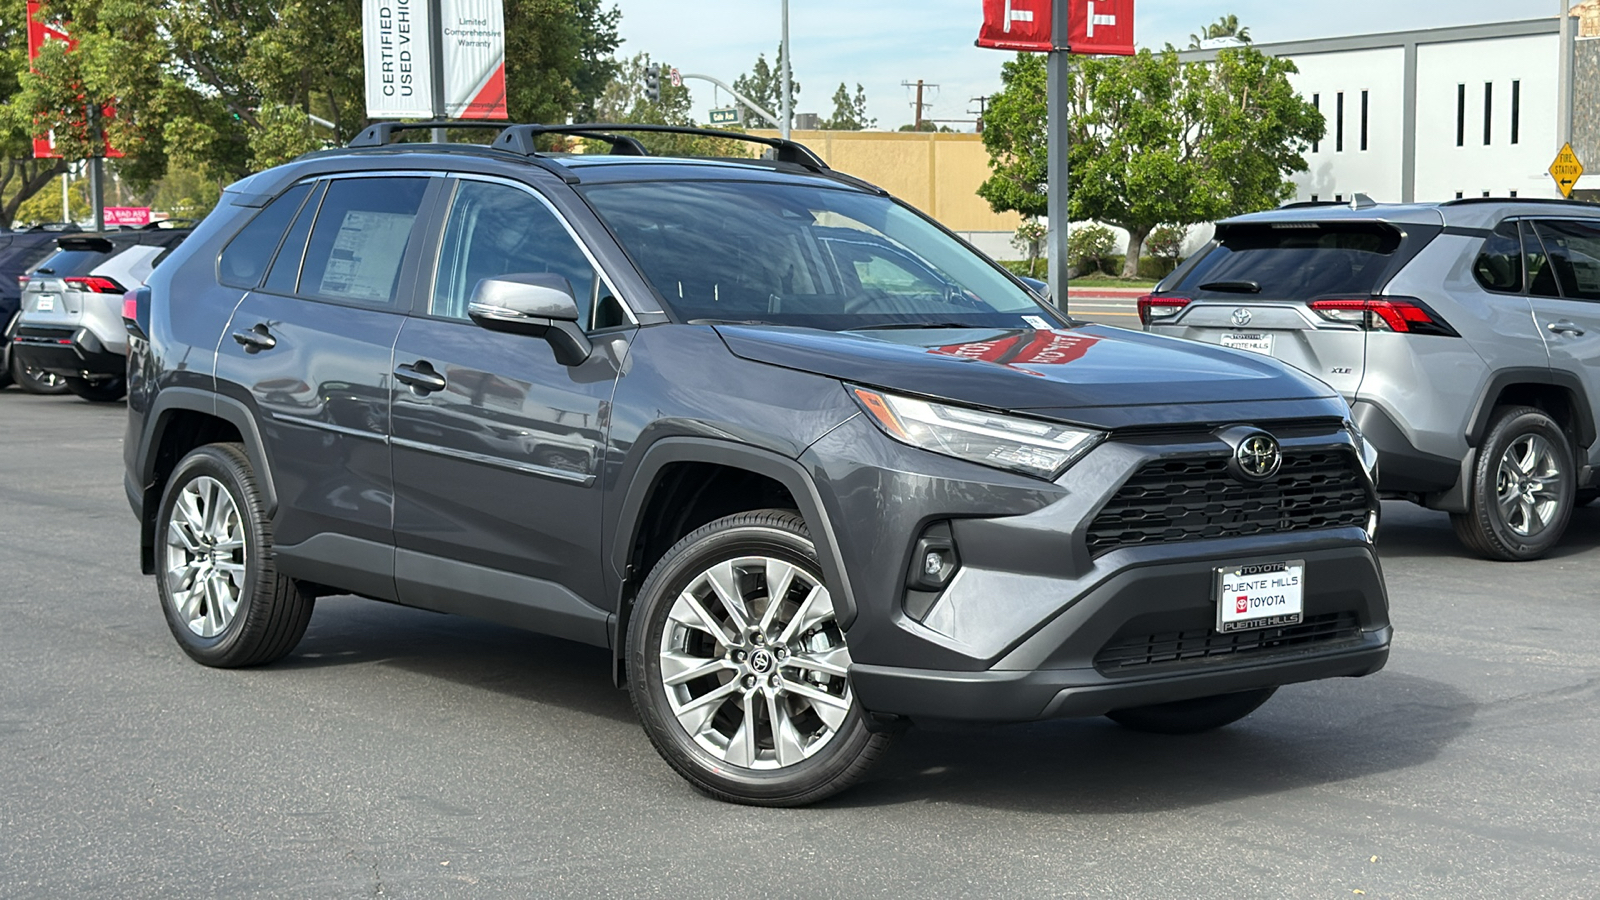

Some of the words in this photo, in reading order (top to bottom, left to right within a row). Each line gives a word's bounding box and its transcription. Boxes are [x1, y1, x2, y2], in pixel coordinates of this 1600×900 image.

[459, 18, 487, 26] Limited
[444, 28, 501, 37] Comprehensive
[458, 40, 491, 49] Warranty
[380, 7, 395, 96] CERTIFIED
[400, 50, 413, 96] USED
[1560, 153, 1572, 163] FIRE
[1555, 165, 1577, 174] STATION
[1242, 562, 1285, 574] TOYOTA
[1223, 580, 1267, 593] PUENTE
[1271, 576, 1298, 588] HILLS
[1249, 595, 1286, 608] TOYOTA
[1224, 619, 1267, 631] PUENTE
[1267, 615, 1298, 625] HILLS
